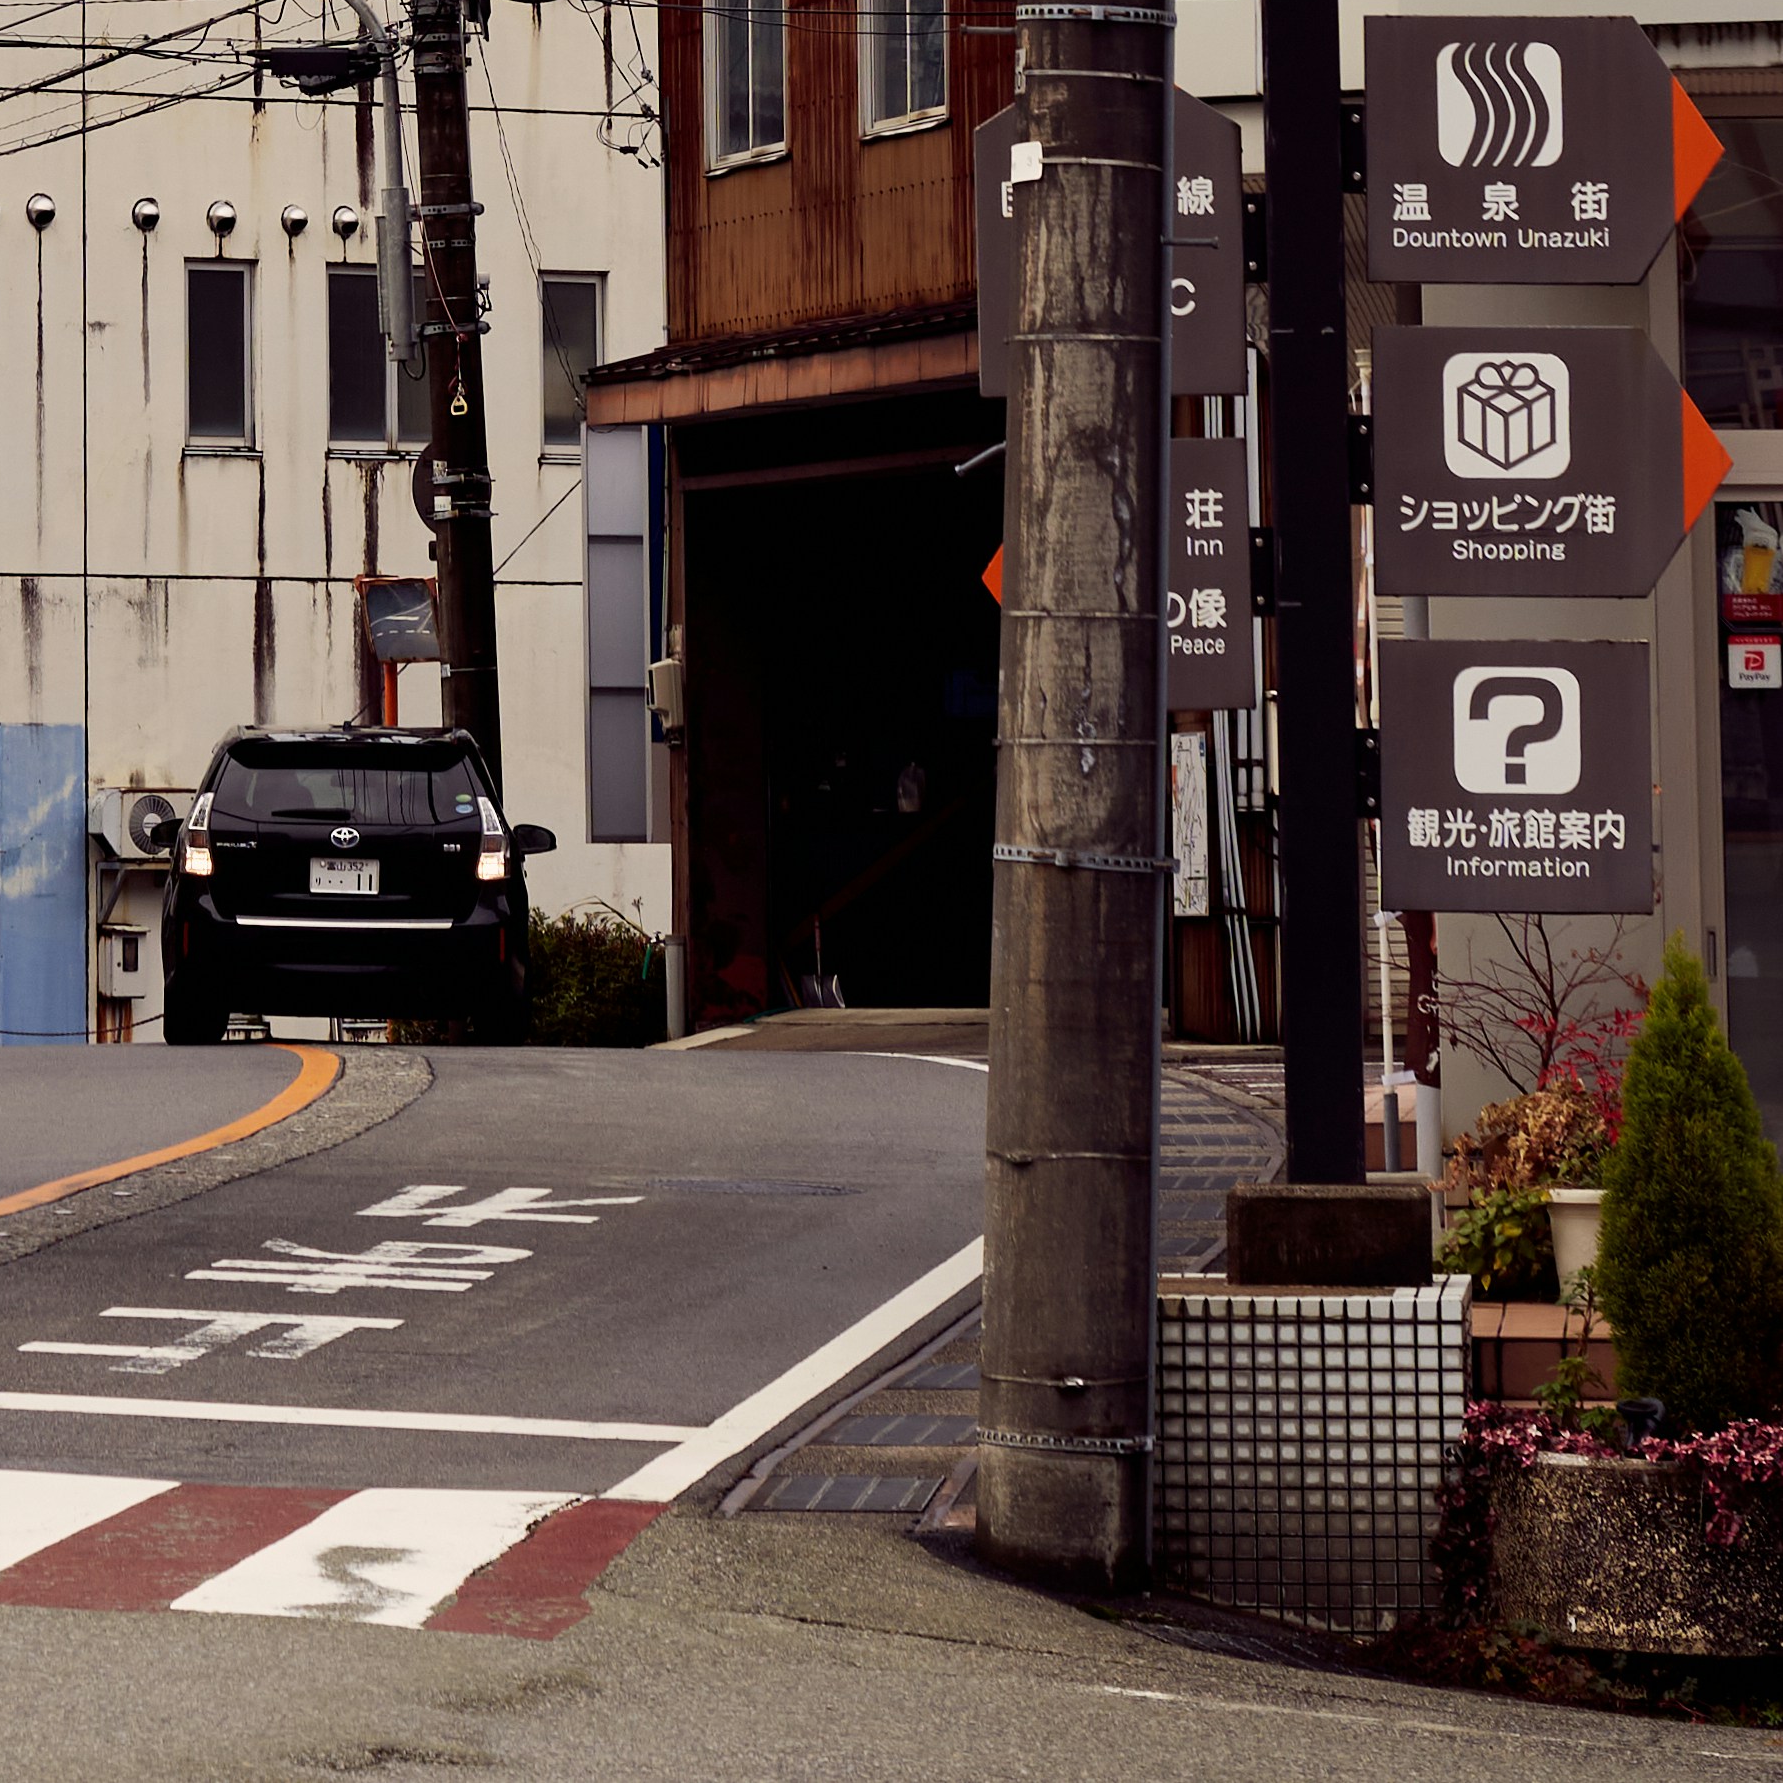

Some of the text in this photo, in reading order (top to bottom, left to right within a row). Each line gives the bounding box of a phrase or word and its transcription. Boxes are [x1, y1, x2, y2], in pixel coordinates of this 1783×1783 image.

[1392, 181, 1611, 222] 温泉街
[1392, 227, 1611, 250] Dountown Unazuki
[1398, 493, 1616, 535] ショッピング街
[1186, 536, 1224, 556] Inn
[1451, 538, 1567, 561] Shopping
[1170, 633, 1227, 656] Peace
[1738, 672, 1771, 684] PayPay
[1407, 806, 1627, 852] 観光・旅館案内
[1445, 855, 1591, 879] Information
